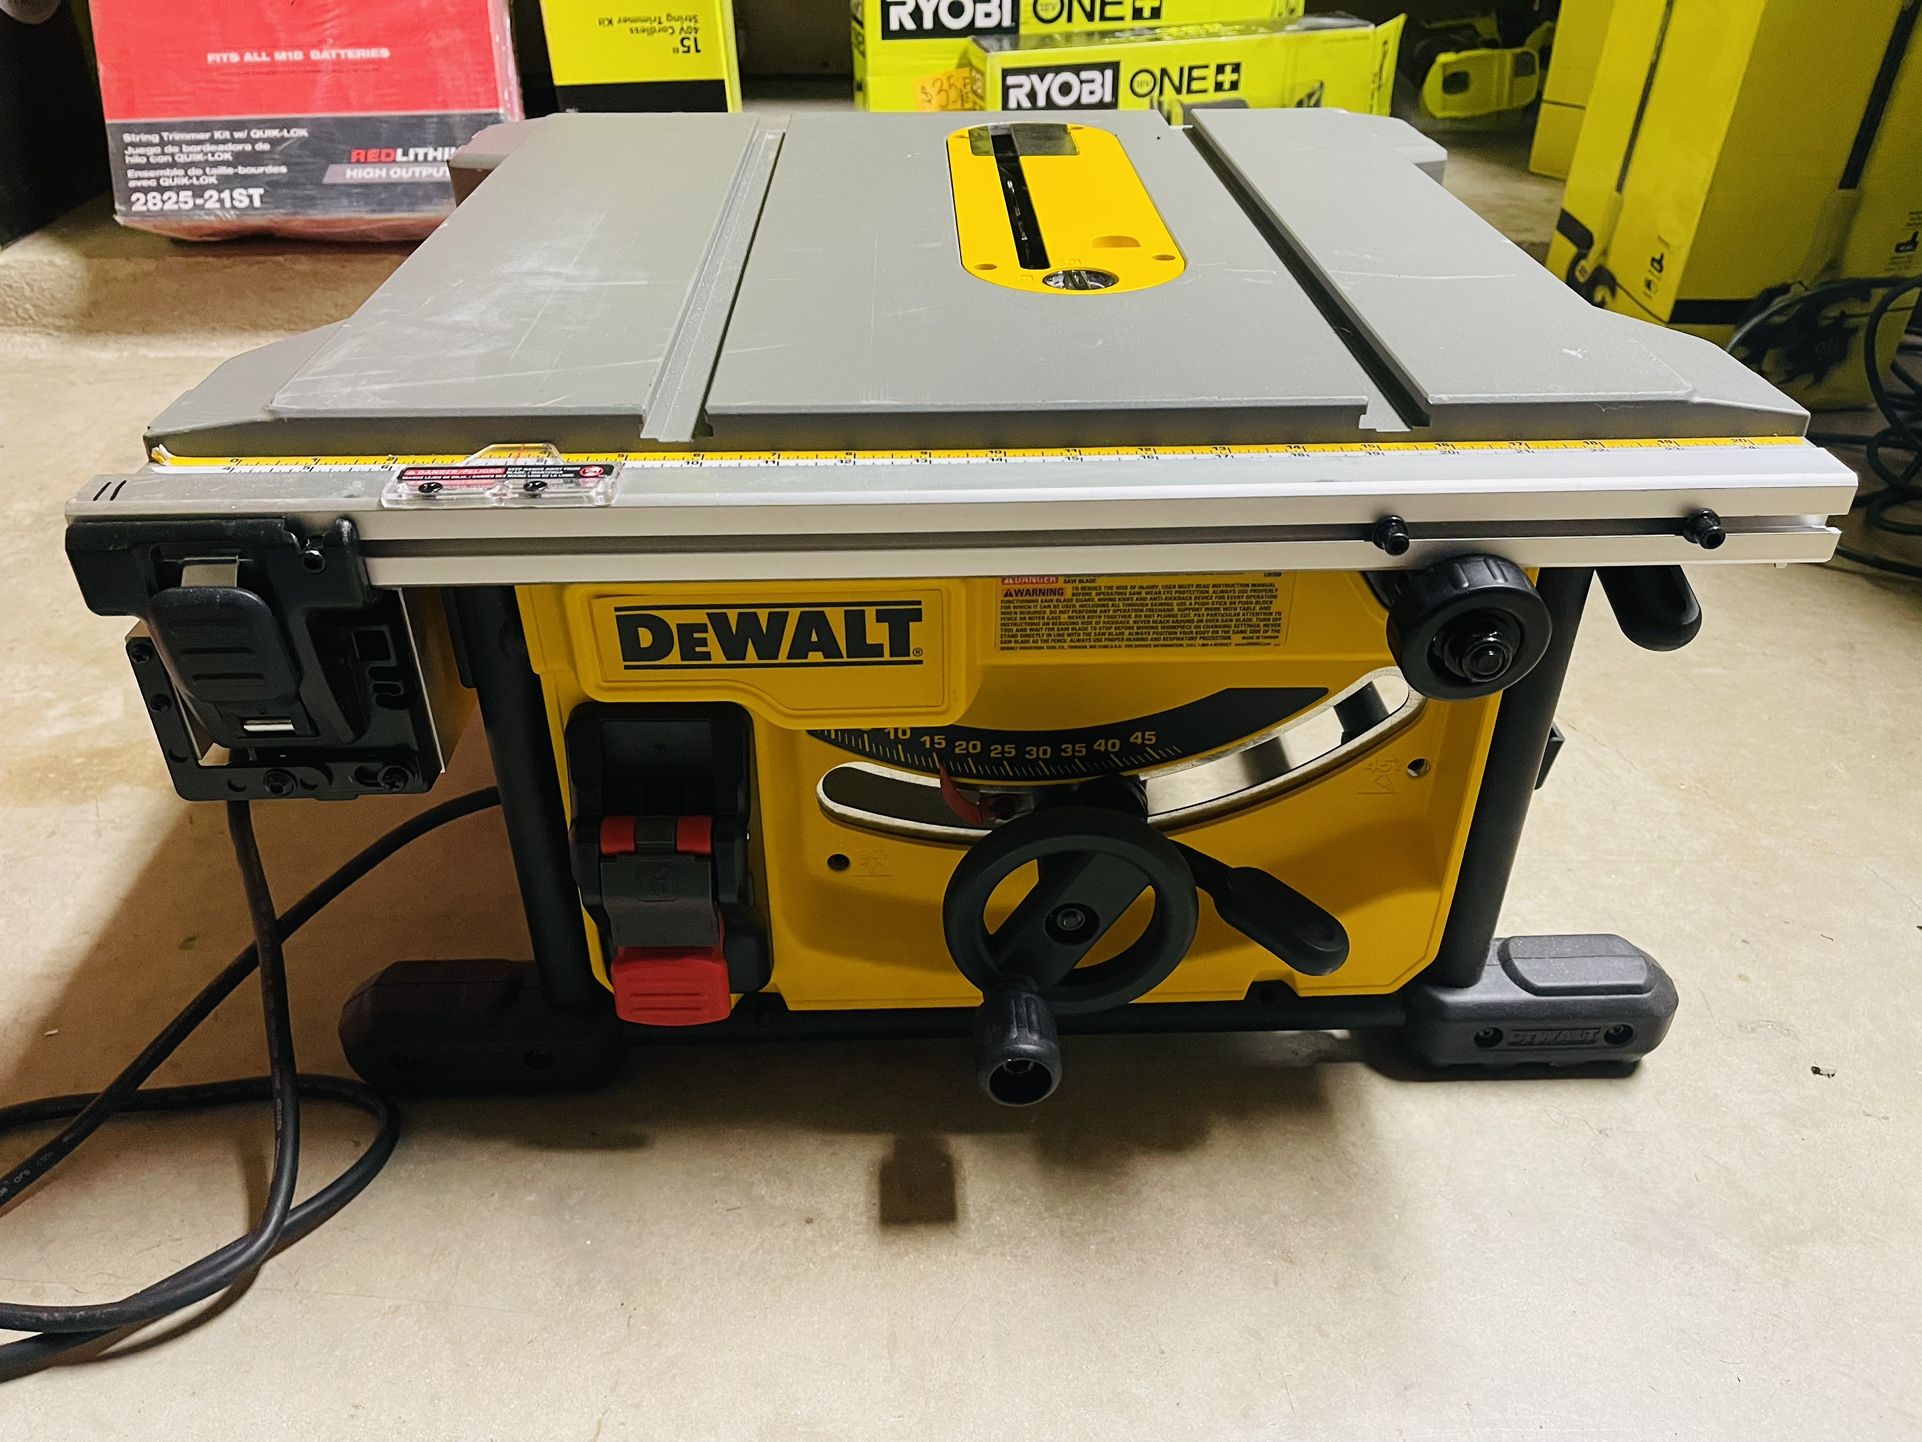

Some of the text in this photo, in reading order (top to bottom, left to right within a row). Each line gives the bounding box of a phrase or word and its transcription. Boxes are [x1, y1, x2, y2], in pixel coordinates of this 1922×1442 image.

[598, 12, 699, 26] String Trimmer Kit
[888, 0, 1012, 33] RYOBI
[207, 52, 240, 64] FITS
[243, 51, 271, 62] ALL
[309, 48, 391, 61] BATTERIES
[1005, 69, 1113, 109] RYOBI
[122, 133, 160, 144] String
[160, 132, 211, 142] Trimmer
[213, 130, 231, 140] Kit
[254, 142, 271, 151] de
[351, 146, 457, 163] REDLITHI
[187, 166, 203, 176] de
[346, 166, 387, 180] HIGH
[130, 187, 265, 213] 2825-21ST
[1014, 588, 1064, 597] WARNING
[884, 728, 1157, 759] 10 15 20 25 30 35 40 45
